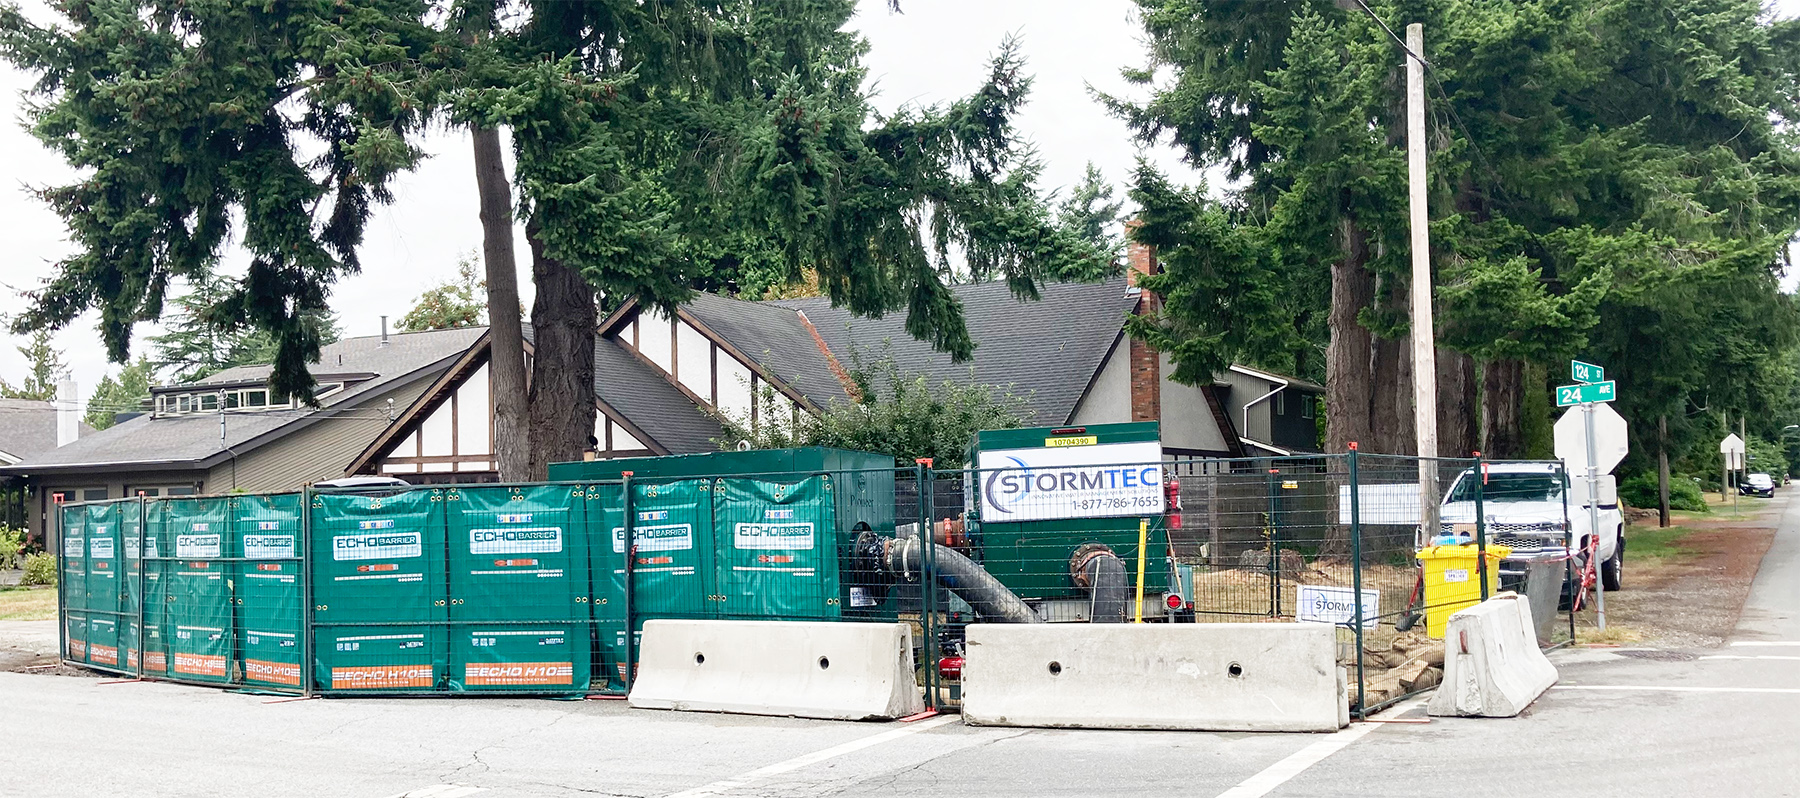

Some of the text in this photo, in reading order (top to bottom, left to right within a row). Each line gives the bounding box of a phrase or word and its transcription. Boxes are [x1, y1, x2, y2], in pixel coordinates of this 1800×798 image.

[1575, 364, 1602, 380] 124 ST
[1562, 385, 1611, 403] 24 AVE
[1054, 438, 1089, 446] 10704390
[1002, 467, 1158, 494] STORMTEC
[1073, 495, 1159, 510] 1-877-786-7655
[474, 531, 556, 541] ECHO BARRIER
[655, 527, 688, 537] BARRIER
[740, 525, 810, 537] ECHO BARRIER
[179, 537, 199, 546] ECHO
[245, 537, 269, 547] ECHO
[337, 536, 416, 548] ECHO BARRIER
[1315, 600, 1368, 613] STORMTC
[182, 657, 202, 667] ECHO
[252, 663, 291, 676] ECHO H10
[343, 669, 419, 680] ECHO H10
[478, 666, 558, 677] ECHO H10
